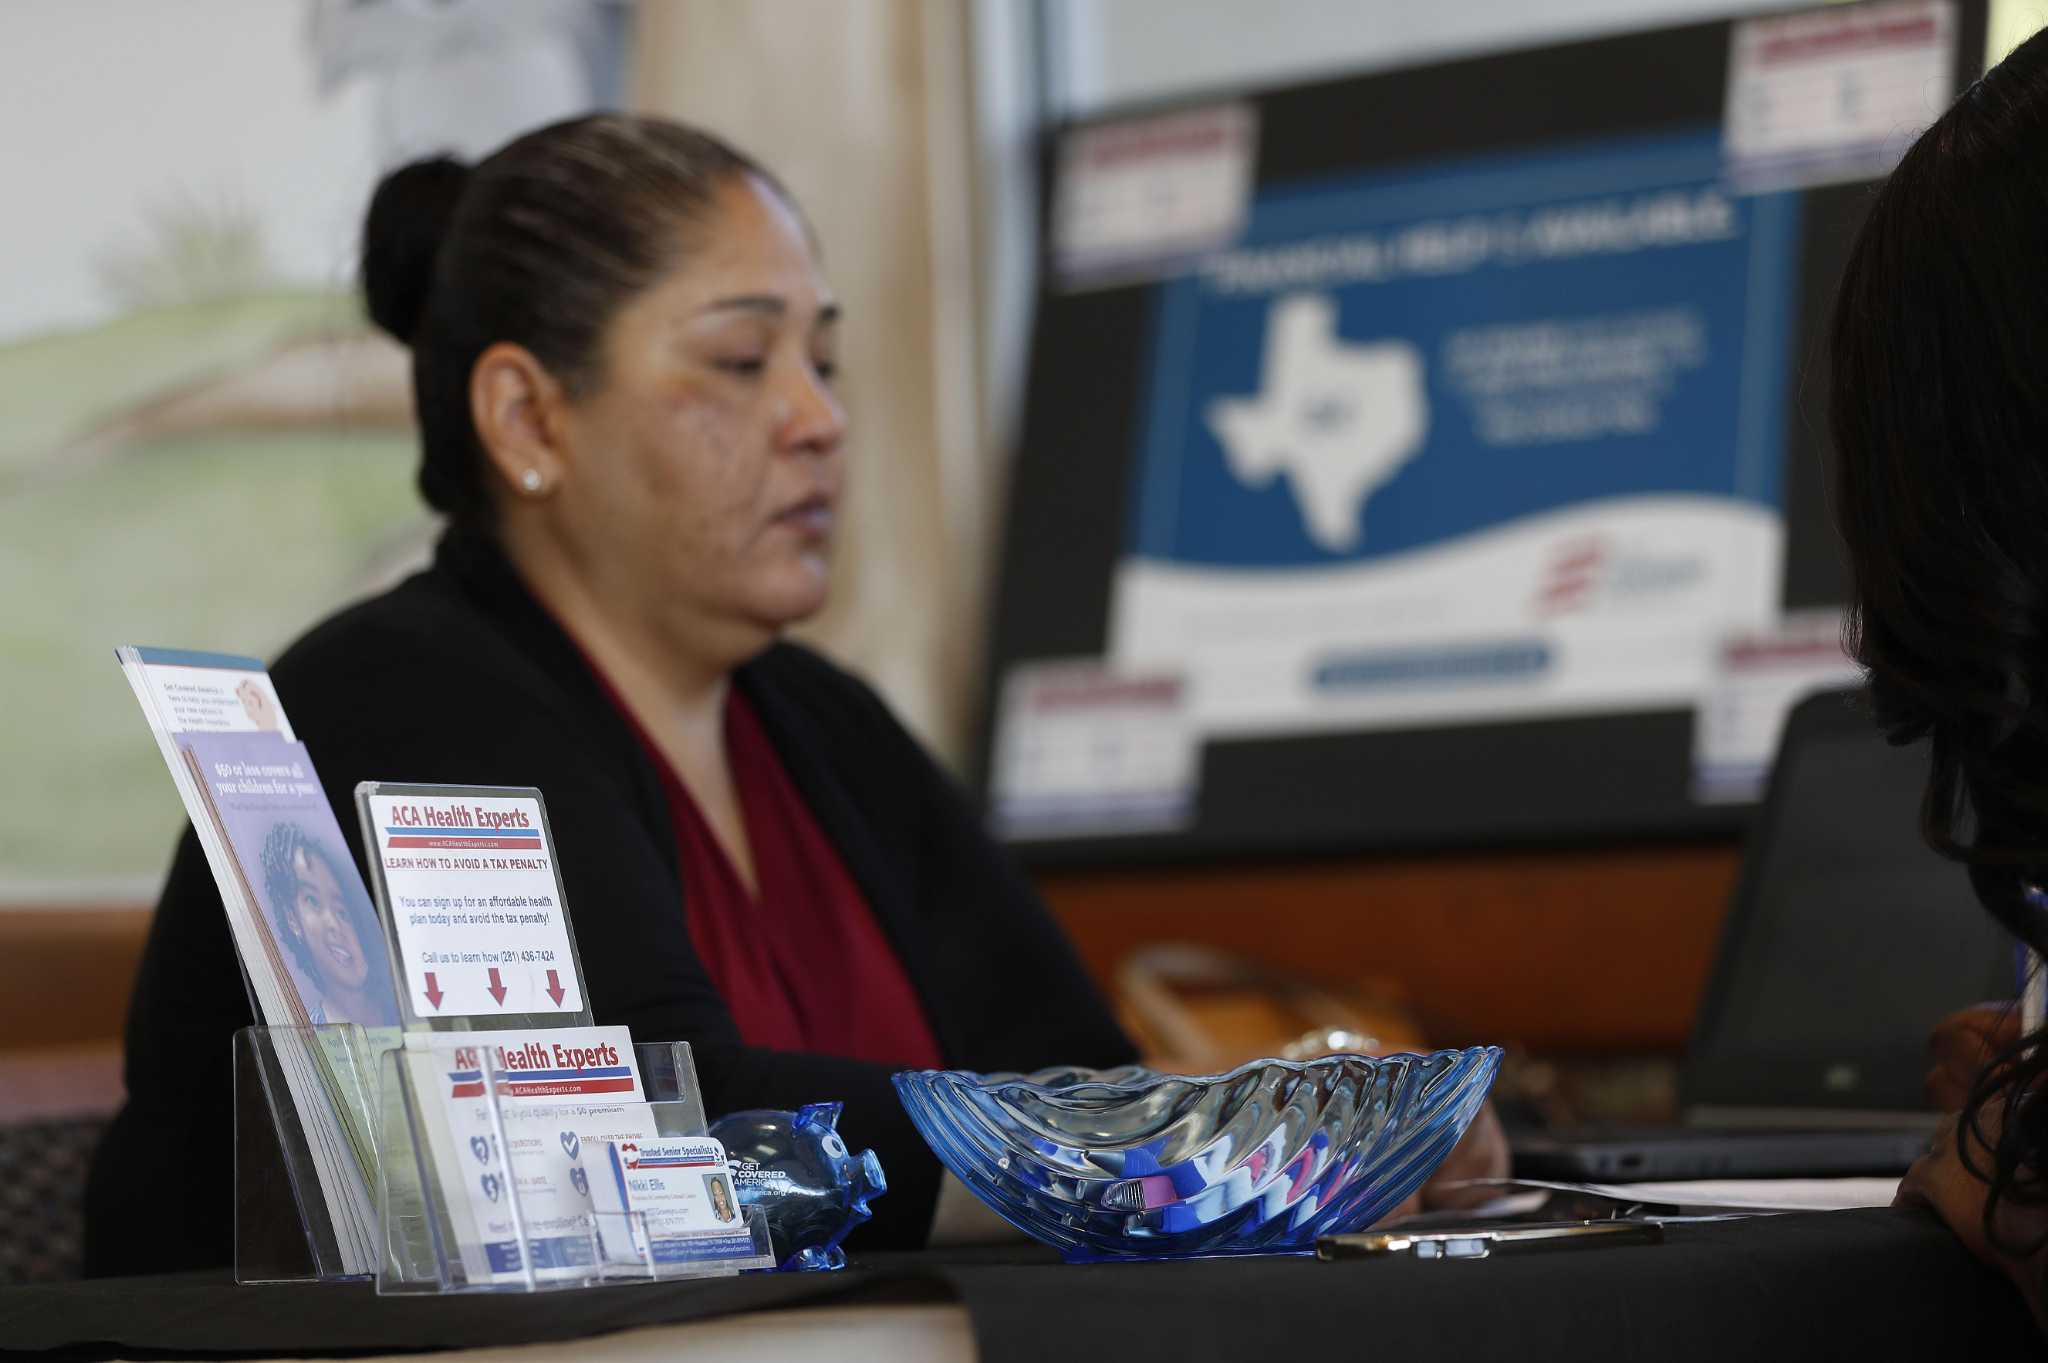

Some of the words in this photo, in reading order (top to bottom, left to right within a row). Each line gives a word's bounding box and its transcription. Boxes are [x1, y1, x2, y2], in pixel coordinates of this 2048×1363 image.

[392, 805, 422, 826] ACA
[424, 805, 473, 827] Health
[475, 807, 530, 832] Experts
[384, 857, 414, 869] LEARN
[415, 858, 437, 869] HOW
[438, 858, 450, 869] TO
[454, 858, 480, 869] AVOID
[482, 859, 490, 869] A
[490, 858, 509, 870] TAX
[511, 858, 548, 870] PENALTY
[399, 897, 416, 907] You
[418, 899, 432, 907] can
[435, 897, 450, 910] sign
[453, 899, 463, 910] up
[464, 896, 476, 907] for
[477, 899, 487, 907] an
[489, 896, 526, 907] affordable
[528, 896, 553, 907] health
[409, 913, 427, 925] plan
[429, 913, 450, 926] today
[453, 913, 466, 924] and
[469, 913, 490, 924] avoid
[491, 913, 504, 923] the
[506, 913, 517, 924] tax
[520, 912, 550, 926] penalty!
[422, 952, 437, 963] Call
[440, 955, 450, 963] us
[451, 953, 460, 963] to
[462, 952, 480, 963] learn
[482, 952, 499, 963] how
[552, 1042, 619, 1072] Experts
[589, 1107, 625, 1117] premium
[640, 1146, 661, 1157] Trusted
[662, 1145, 681, 1157] Senior
[682, 1145, 714, 1157] Specialists
[742, 1163, 760, 1171] GET
[738, 1171, 786, 1179] COVERED
